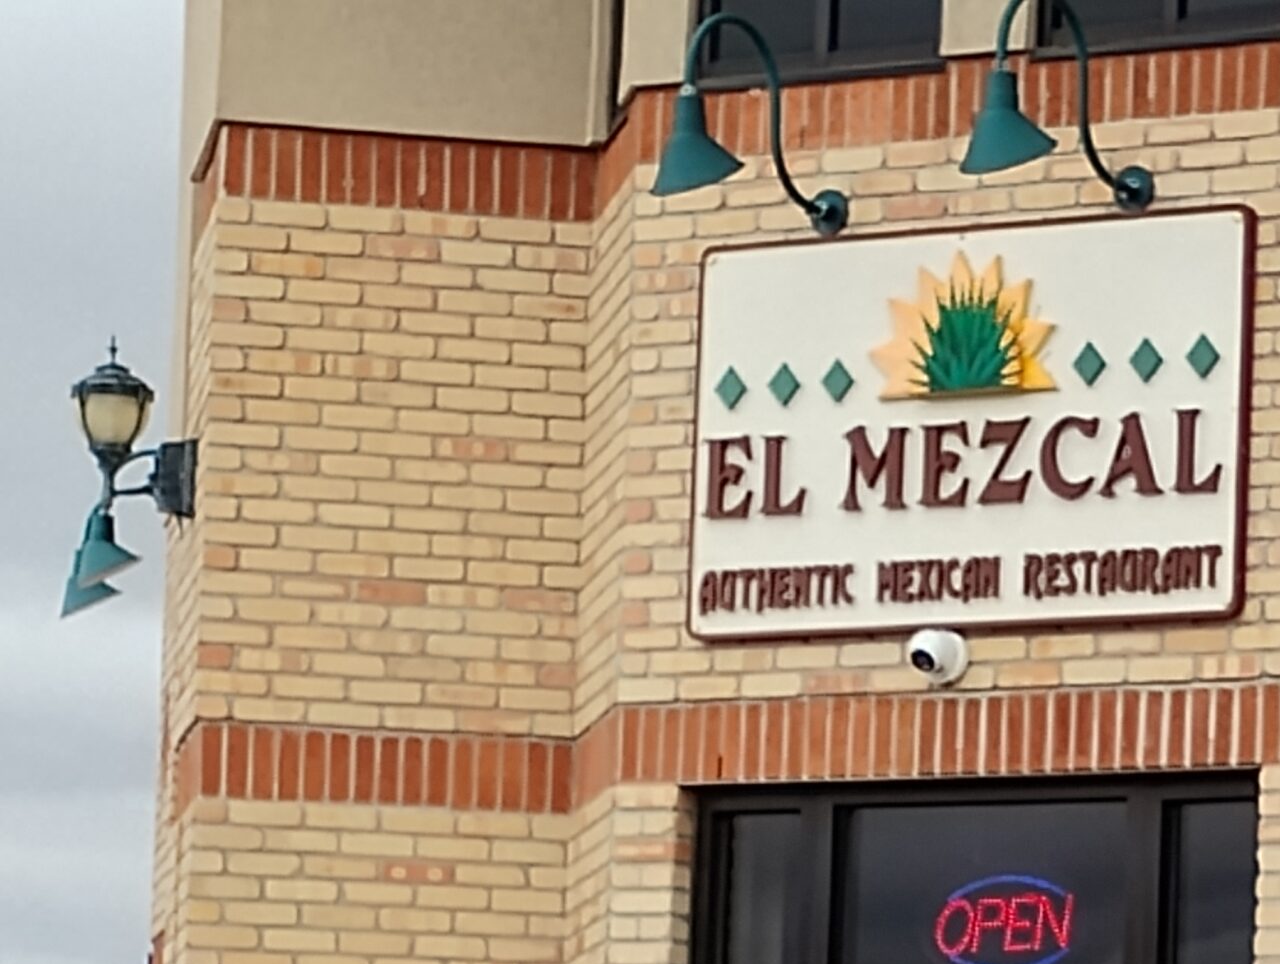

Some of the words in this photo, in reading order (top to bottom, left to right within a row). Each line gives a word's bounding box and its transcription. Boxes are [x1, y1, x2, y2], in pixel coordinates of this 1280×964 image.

[701, 434, 807, 521] EL
[839, 408, 1224, 514] MEZCAL
[699, 561, 856, 617] AUTHENTIC
[876, 554, 1001, 605] MEXICAN
[1023, 543, 1224, 600] RESTAURANT
[934, 892, 1075, 958] OPEN
